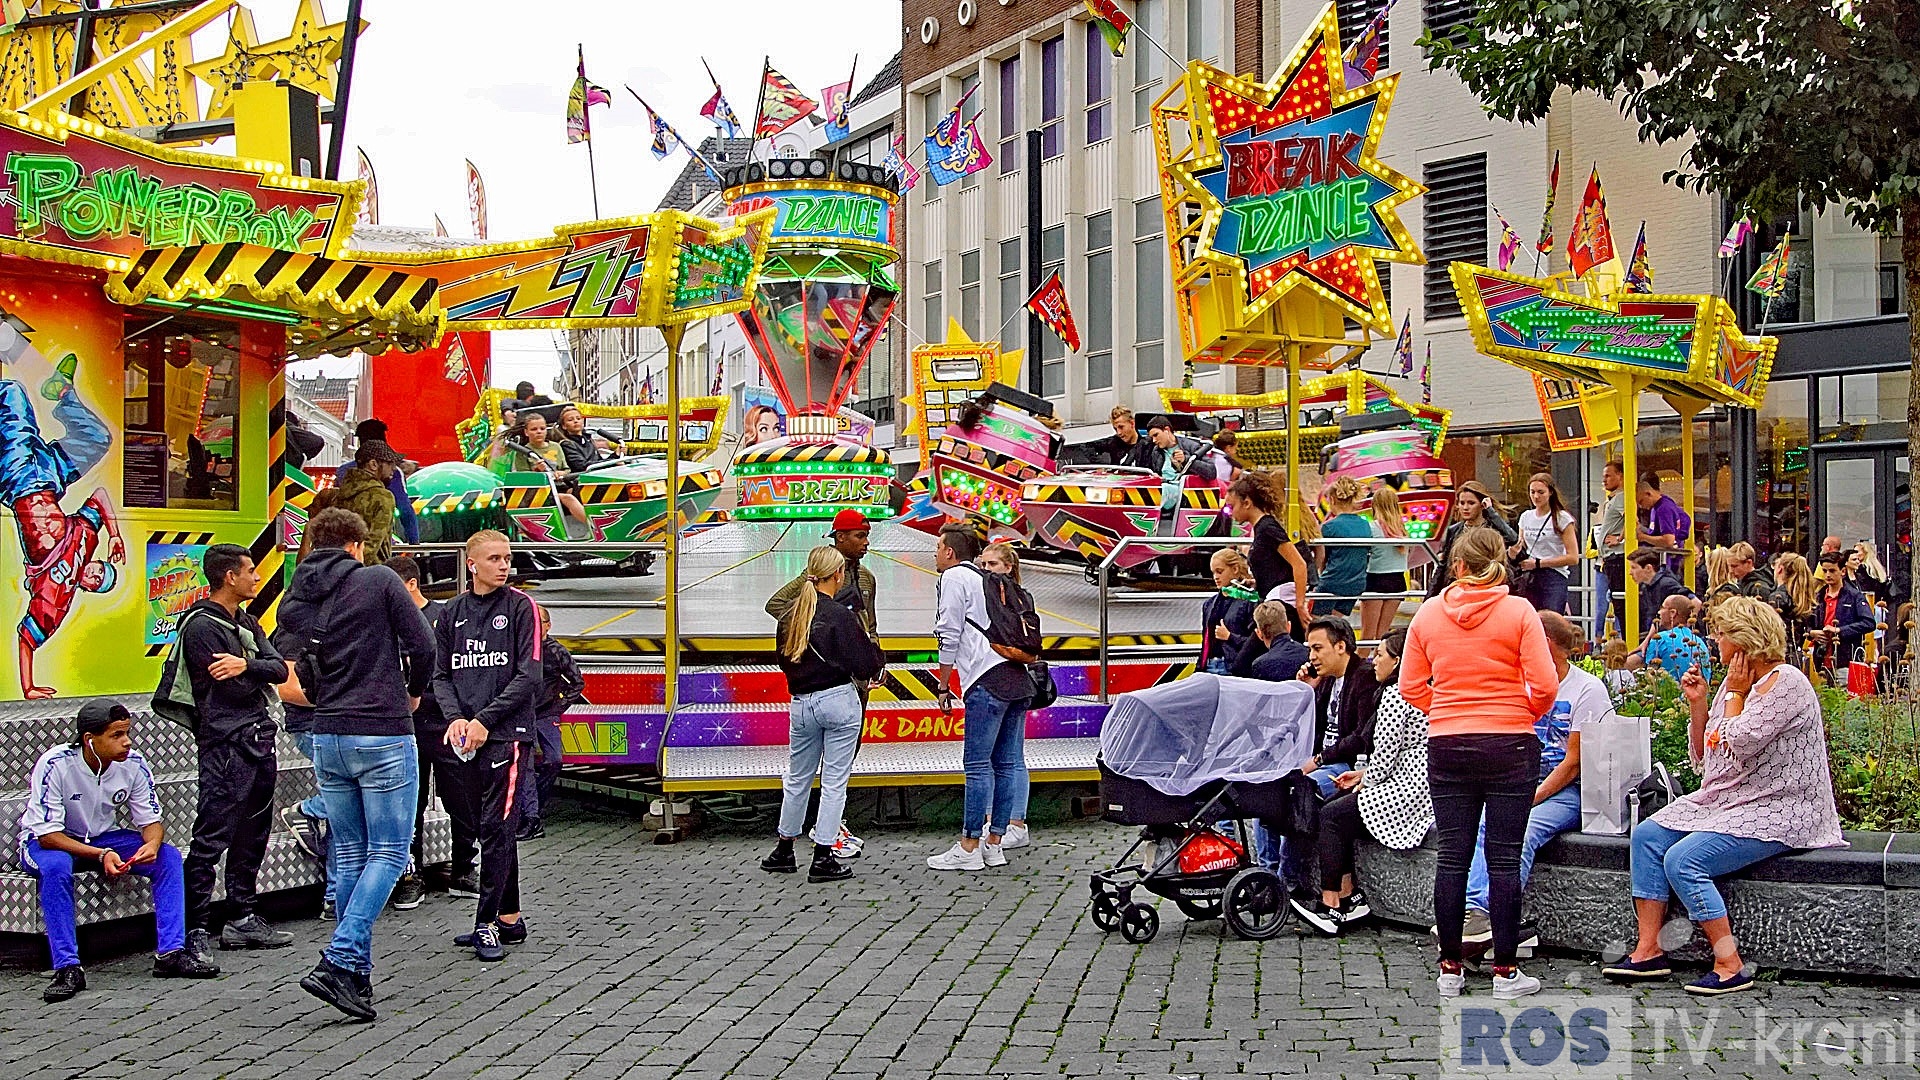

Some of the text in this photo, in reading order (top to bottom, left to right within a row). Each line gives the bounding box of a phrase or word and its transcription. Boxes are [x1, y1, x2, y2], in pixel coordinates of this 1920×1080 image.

[1223, 129, 1365, 200] BREAK
[779, 195, 882, 238] DANCE
[1222, 178, 1371, 254] DANCE
[1566, 324, 1638, 335] BREAK
[1605, 332, 1675, 348] DANCE
[786, 478, 861, 504] BREAK
[148, 569, 197, 601] BREAK
[466, 639, 487, 653] Fly
[451, 650, 509, 670] Emirates
[897, 716, 965, 738] DANC
